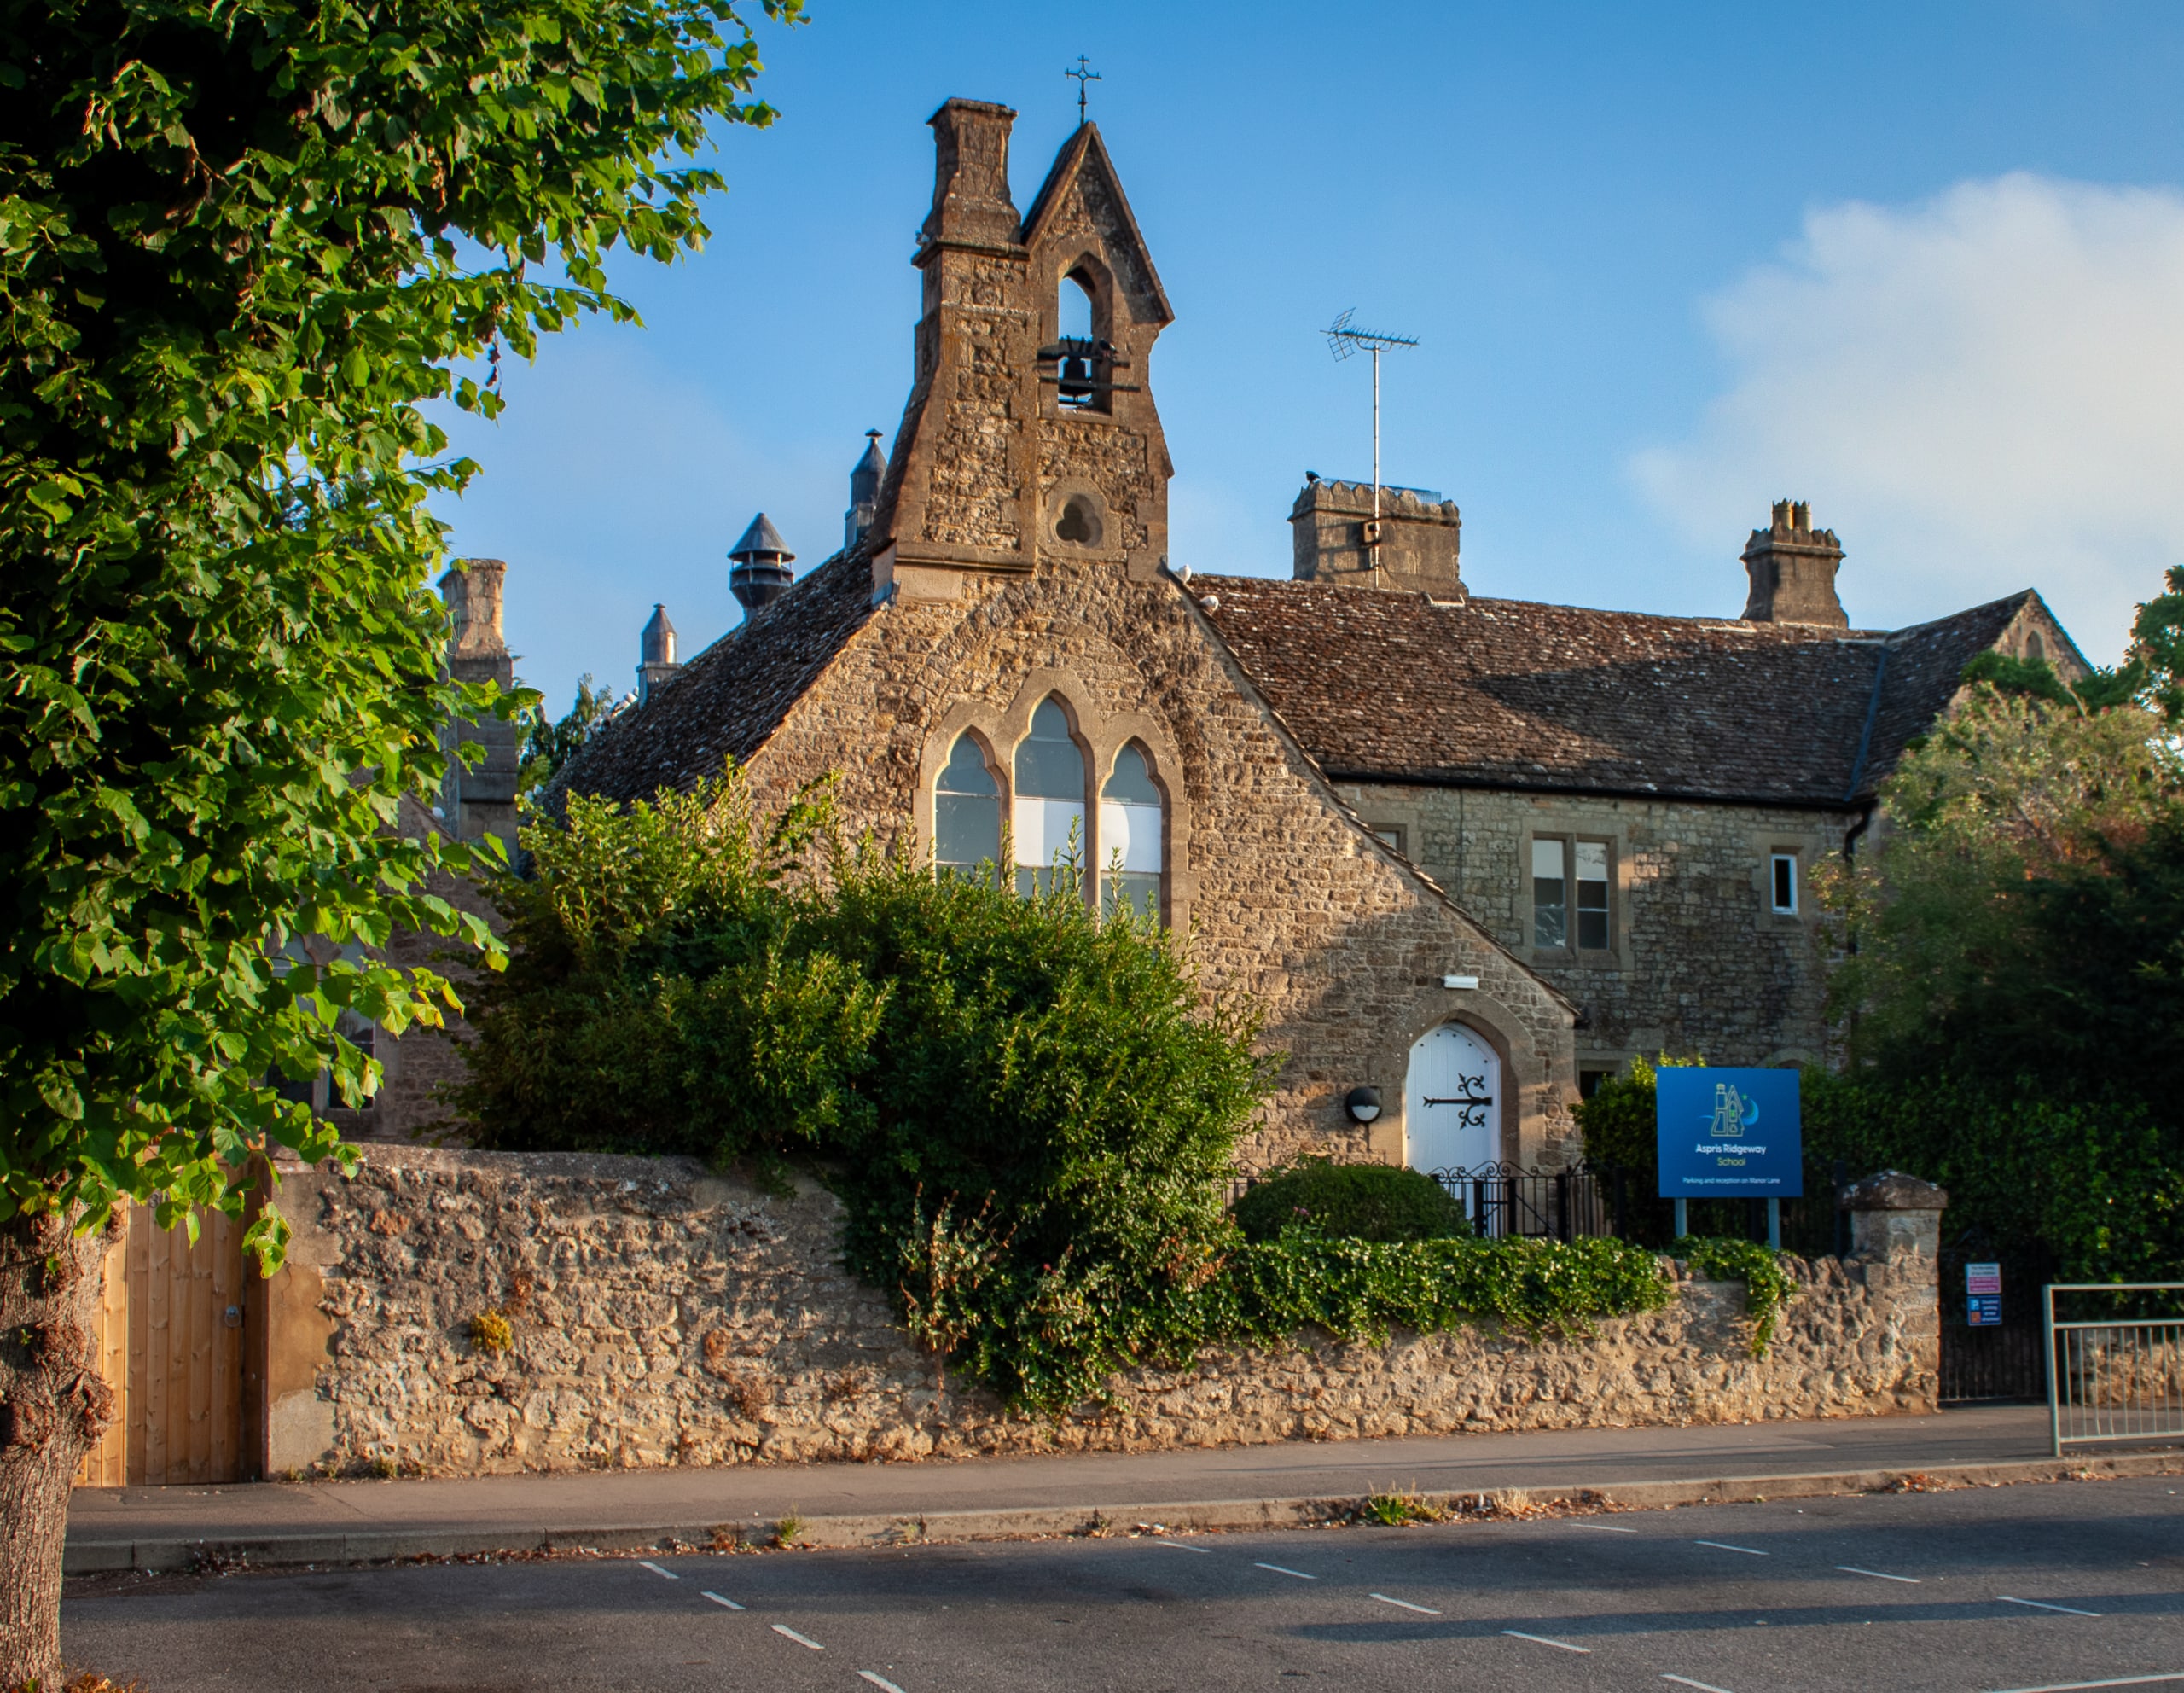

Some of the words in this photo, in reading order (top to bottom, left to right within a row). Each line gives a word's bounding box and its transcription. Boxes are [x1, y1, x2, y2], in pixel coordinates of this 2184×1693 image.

[1695, 1143, 1722, 1155] Aspris
[1723, 1143, 1767, 1155] Ridgeway
[1717, 1156, 1746, 1166] School
[1683, 1177, 1704, 1185] Parking
[1716, 1177, 1740, 1185] reception
